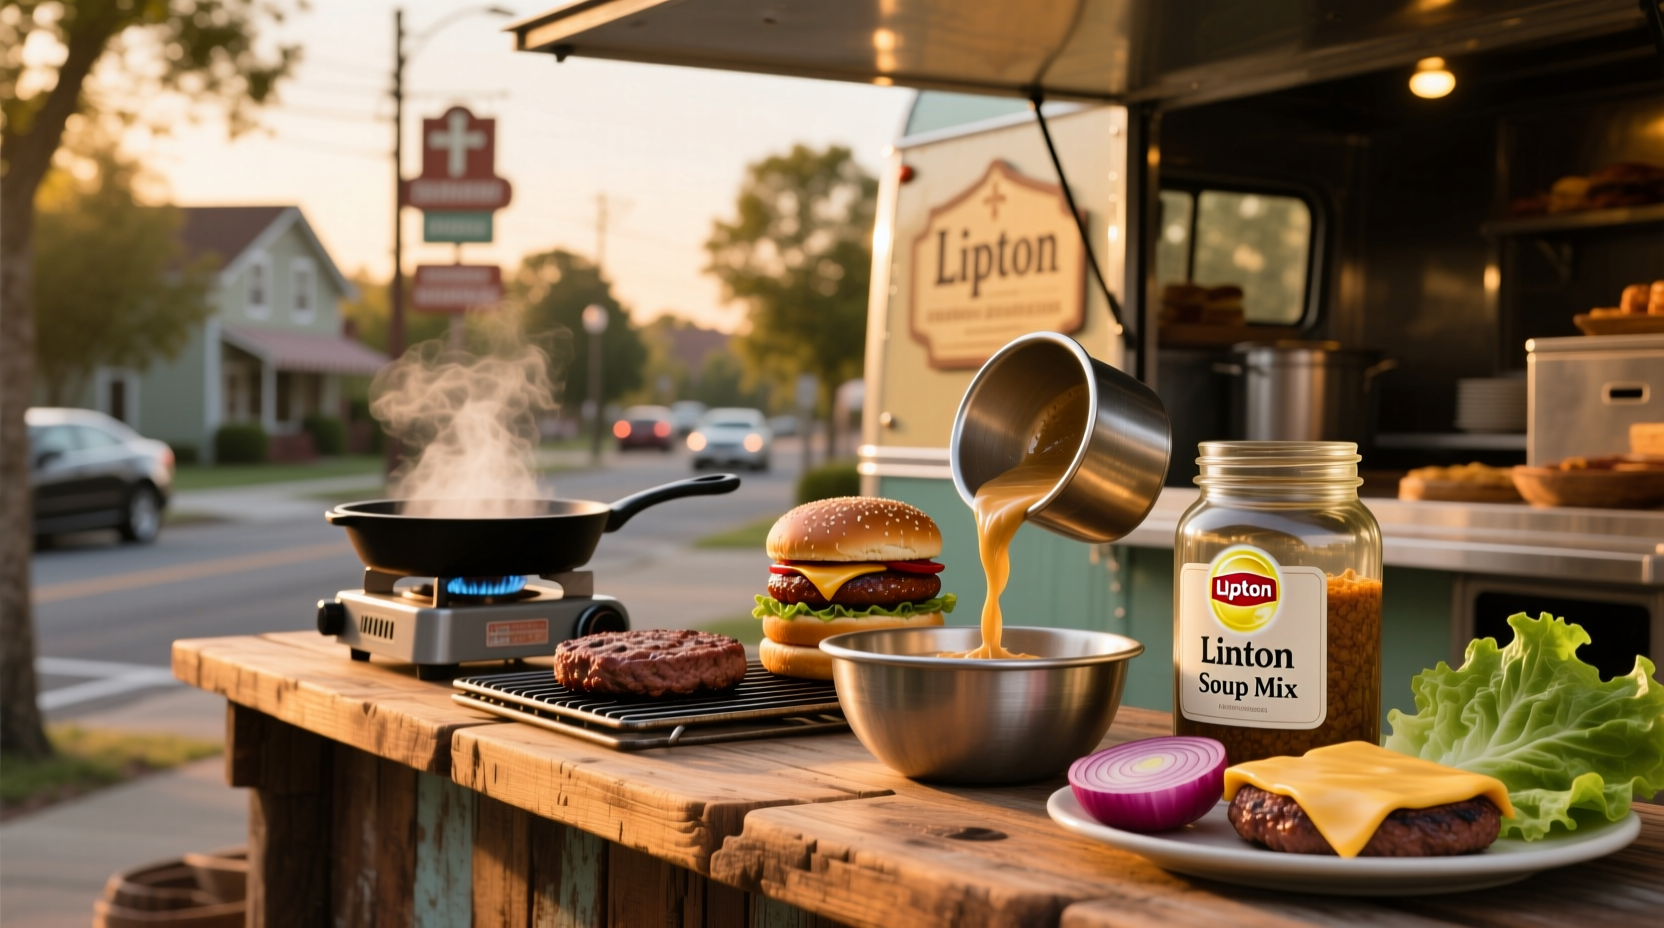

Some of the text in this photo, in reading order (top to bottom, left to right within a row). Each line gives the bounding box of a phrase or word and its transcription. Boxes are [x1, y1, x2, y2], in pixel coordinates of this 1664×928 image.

[935, 228, 1059, 298] Lipton
[1201, 636, 1295, 669] Linton
[1199, 672, 1298, 701] Soup Mix
